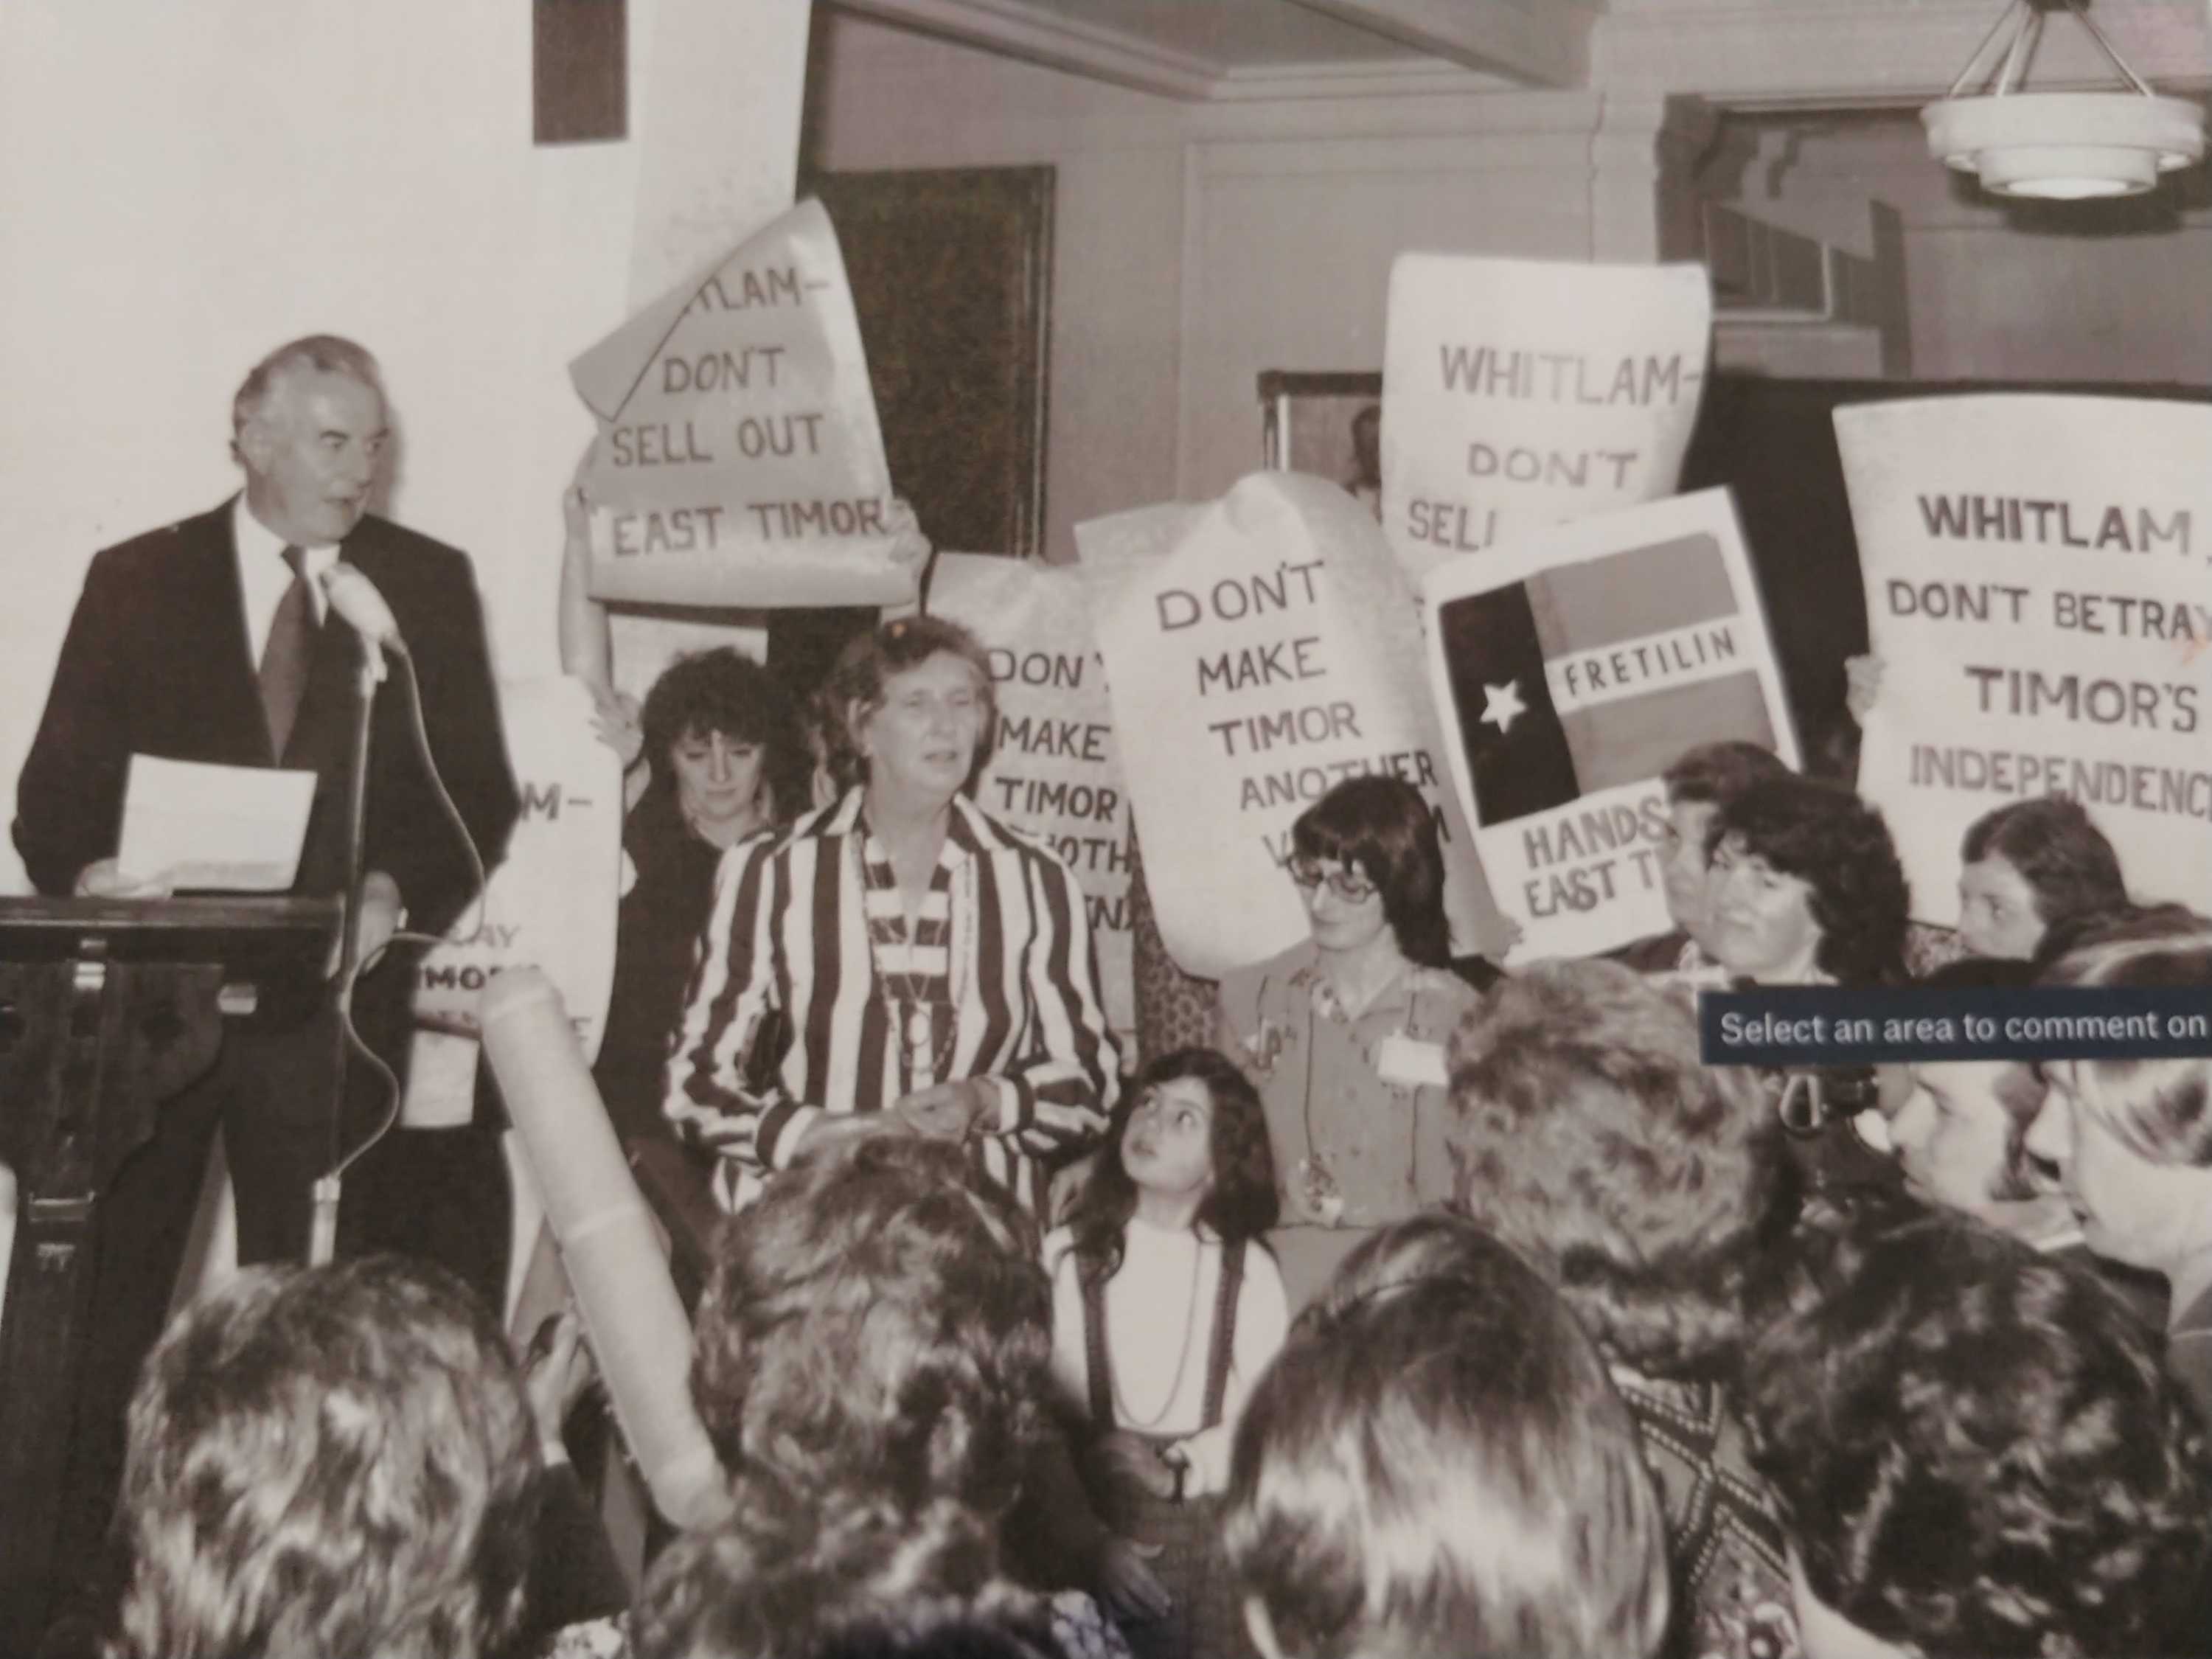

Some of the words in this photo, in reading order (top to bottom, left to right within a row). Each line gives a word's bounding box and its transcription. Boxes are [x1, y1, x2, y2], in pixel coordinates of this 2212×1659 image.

[693, 267, 830, 313] TLAM-
[663, 346, 785, 394] DON'T
[1439, 344, 1700, 406] WHITLAM-
[612, 421, 714, 467] SELL
[738, 413, 824, 459] OUT
[1467, 442, 1638, 490] DON'T
[613, 506, 724, 558] EAST
[747, 498, 885, 541] TIMOR
[1155, 558, 1325, 632] DON'T
[1886, 579, 2030, 623] DON'T
[987, 649, 1110, 693] DON'
[1197, 636, 1329, 697] MAKE
[1563, 625, 1736, 697] FRETILIN
[1208, 700, 1362, 757] TIMOR
[1964, 666, 2199, 734] TIMOR'S
[998, 716, 1112, 762] MAKE
[995, 777, 1119, 823] TIMOR
[1909, 744, 2212, 821] INDEPENDENC
[1523, 796, 1666, 870] HANDS
[1524, 860, 1617, 919] EAST
